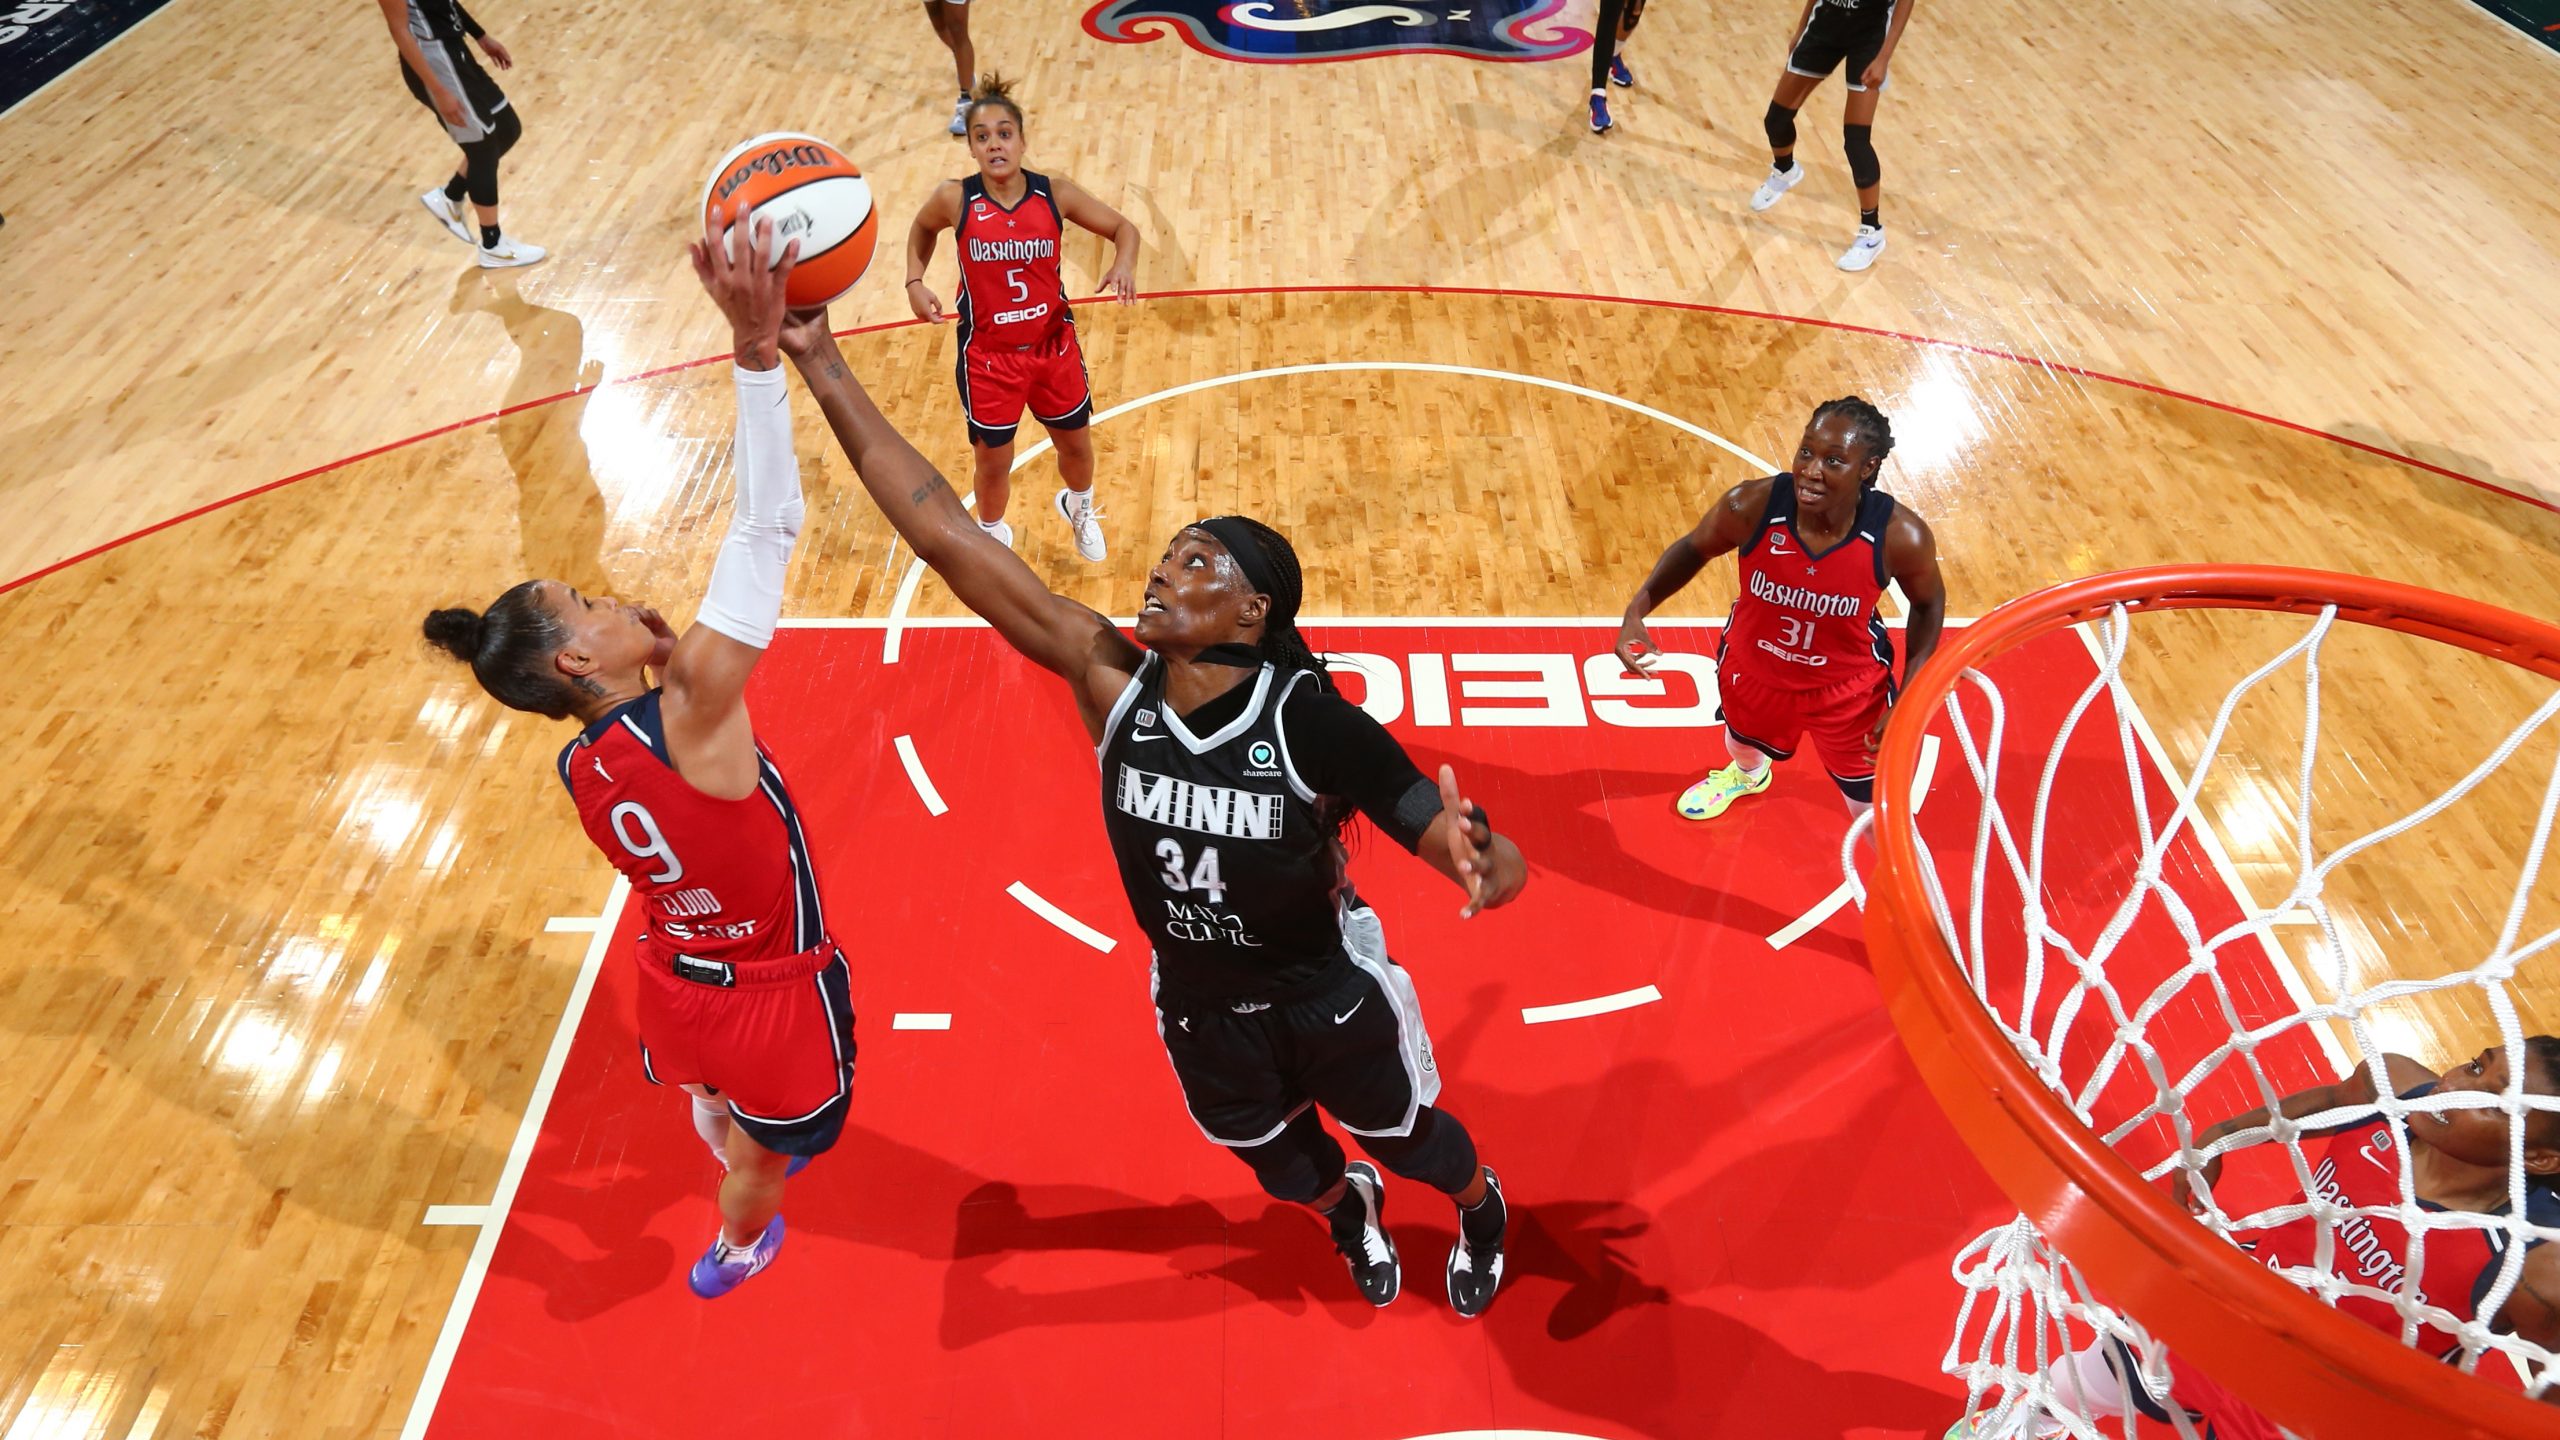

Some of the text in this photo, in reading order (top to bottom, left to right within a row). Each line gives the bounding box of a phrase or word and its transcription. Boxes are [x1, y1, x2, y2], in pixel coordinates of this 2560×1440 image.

[1826, 0, 1860, 9] INIC
[718, 145, 832, 199] Wilson
[969, 237, 1054, 265] Washington
[1005, 267, 1029, 303] 5
[993, 302, 1048, 325] GEICO
[1750, 569, 1860, 618] Washington
[1776, 615, 1816, 651] 31
[1757, 638, 1828, 667] GEICO
[1311, 652, 1727, 728] GEIC
[1242, 769, 1282, 777] sharecare
[1117, 762, 1284, 840] MINN
[610, 801, 684, 883] 9
[1155, 837, 1227, 904] 34
[653, 887, 722, 916] CLOUD
